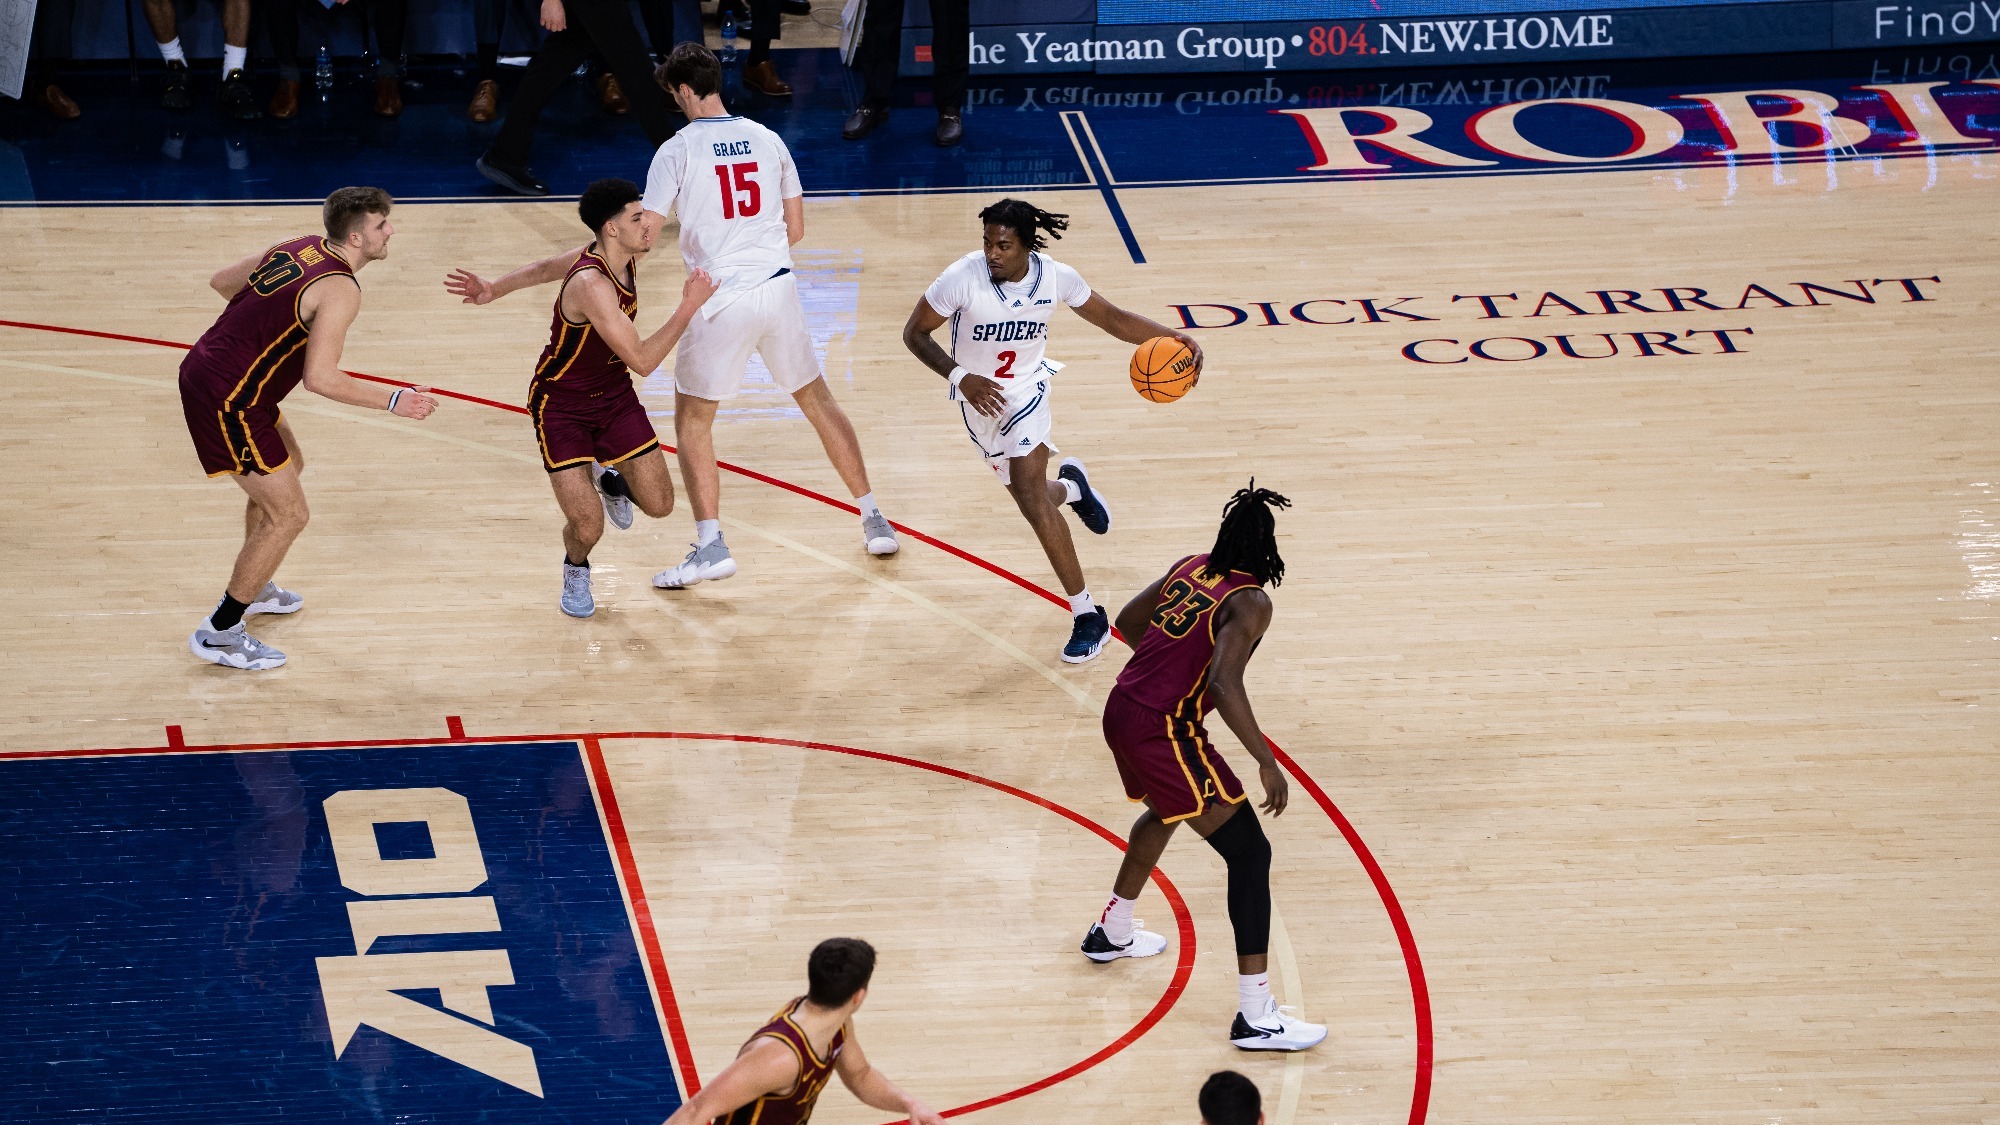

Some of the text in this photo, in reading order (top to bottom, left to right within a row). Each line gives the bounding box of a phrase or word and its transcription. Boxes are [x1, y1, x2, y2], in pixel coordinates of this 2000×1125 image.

[968, 31, 1006, 64] he
[1016, 31, 1166, 63] Yeatman
[1176, 27, 1286, 69] Group
[1267, 78, 2000, 172] ROBI
[713, 140, 752, 157] GRACE
[714, 161, 761, 220] 15
[247, 250, 304, 296] 10
[1165, 275, 1941, 329] DICK TARRANT
[993, 350, 1017, 379] 2
[1401, 326, 1754, 365] COURT
[1151, 577, 1218, 639] 23
